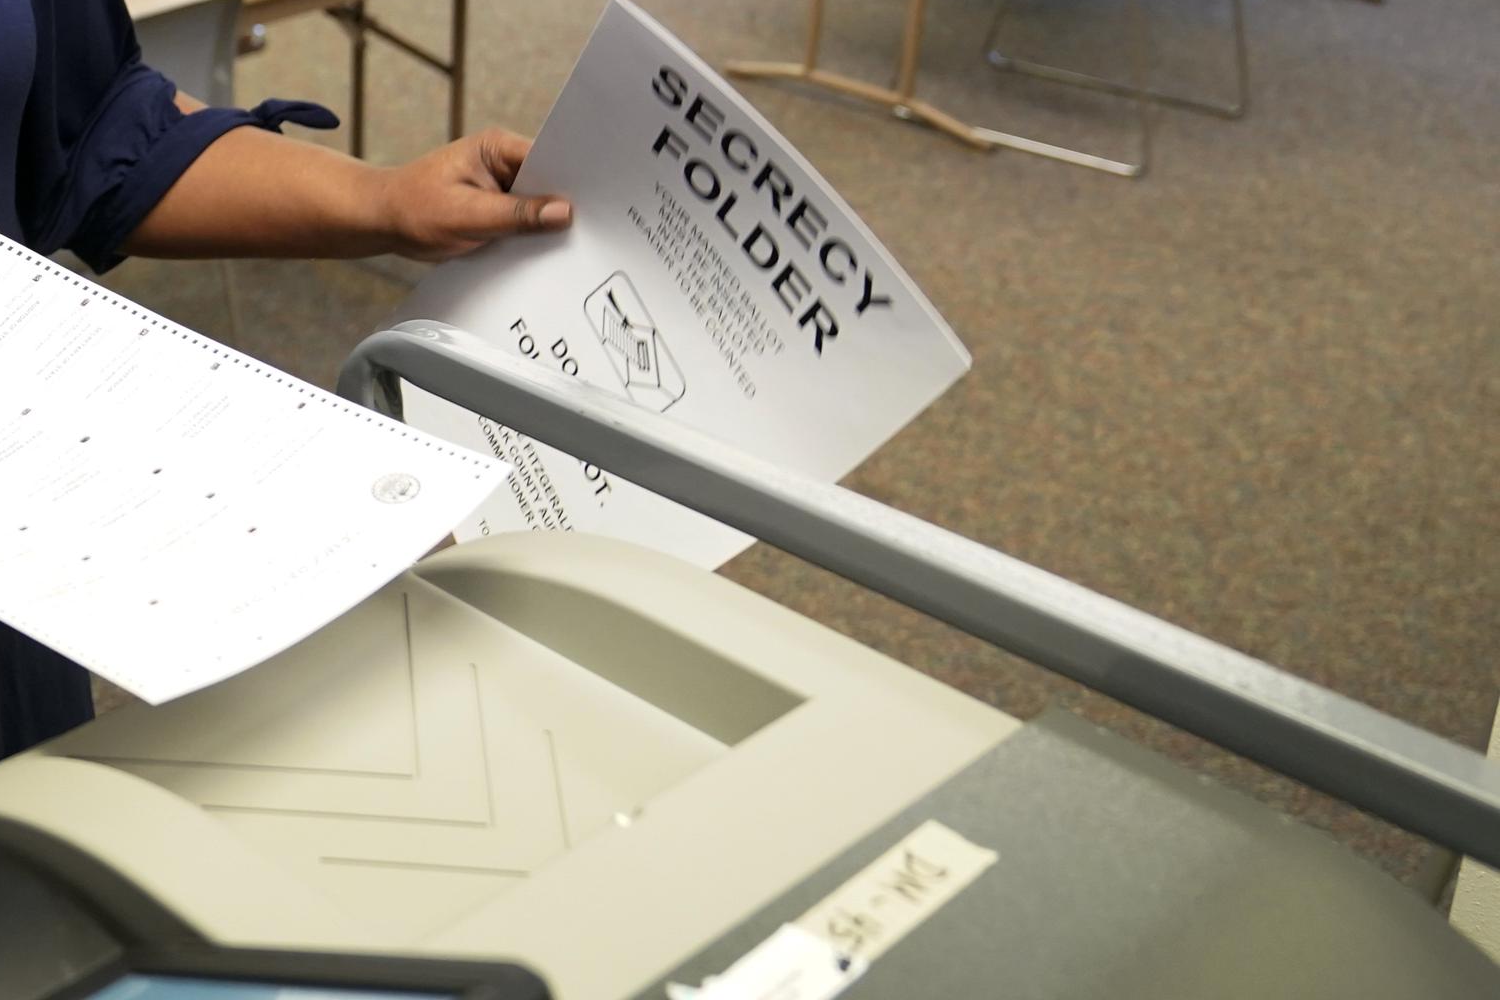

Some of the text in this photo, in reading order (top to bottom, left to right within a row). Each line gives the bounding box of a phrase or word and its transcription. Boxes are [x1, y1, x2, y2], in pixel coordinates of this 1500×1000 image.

[651, 64, 893, 319] SECRECY
[651, 126, 840, 356] FOLDER
[655, 181, 786, 357] YOUR MARKED BALLOT
[550, 337, 579, 377] DO
[627, 205, 757, 401] READER TO BE COUNTED
[656, 222, 750, 357] INTO THE BALLOT
[658, 203, 766, 356] MUST BE INSERTED
[508, 444, 542, 504] COUNTY
